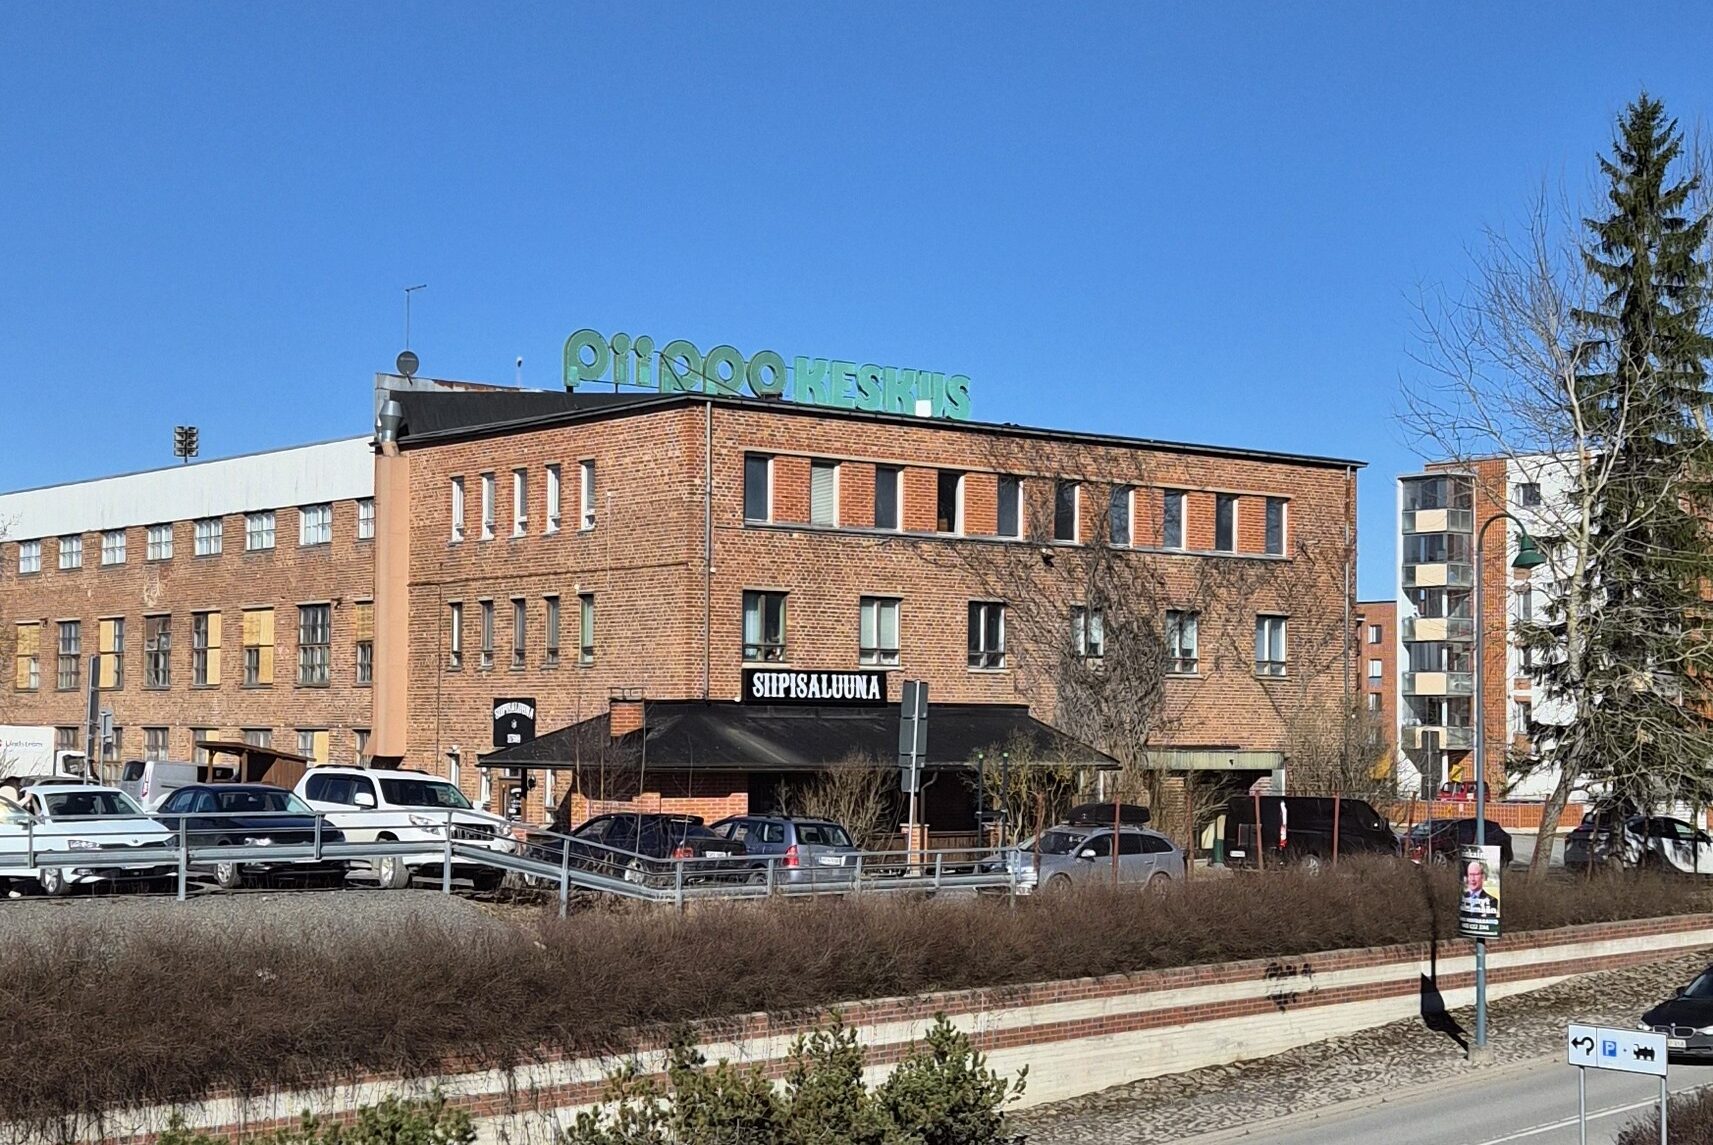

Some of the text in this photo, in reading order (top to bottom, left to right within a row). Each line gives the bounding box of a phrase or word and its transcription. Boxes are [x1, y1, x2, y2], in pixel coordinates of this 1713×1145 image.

[793, 355, 972, 419] KESKUS
[752, 672, 881, 699] SIIPISALUUNA
[1605, 1041, 1615, 1056] P
